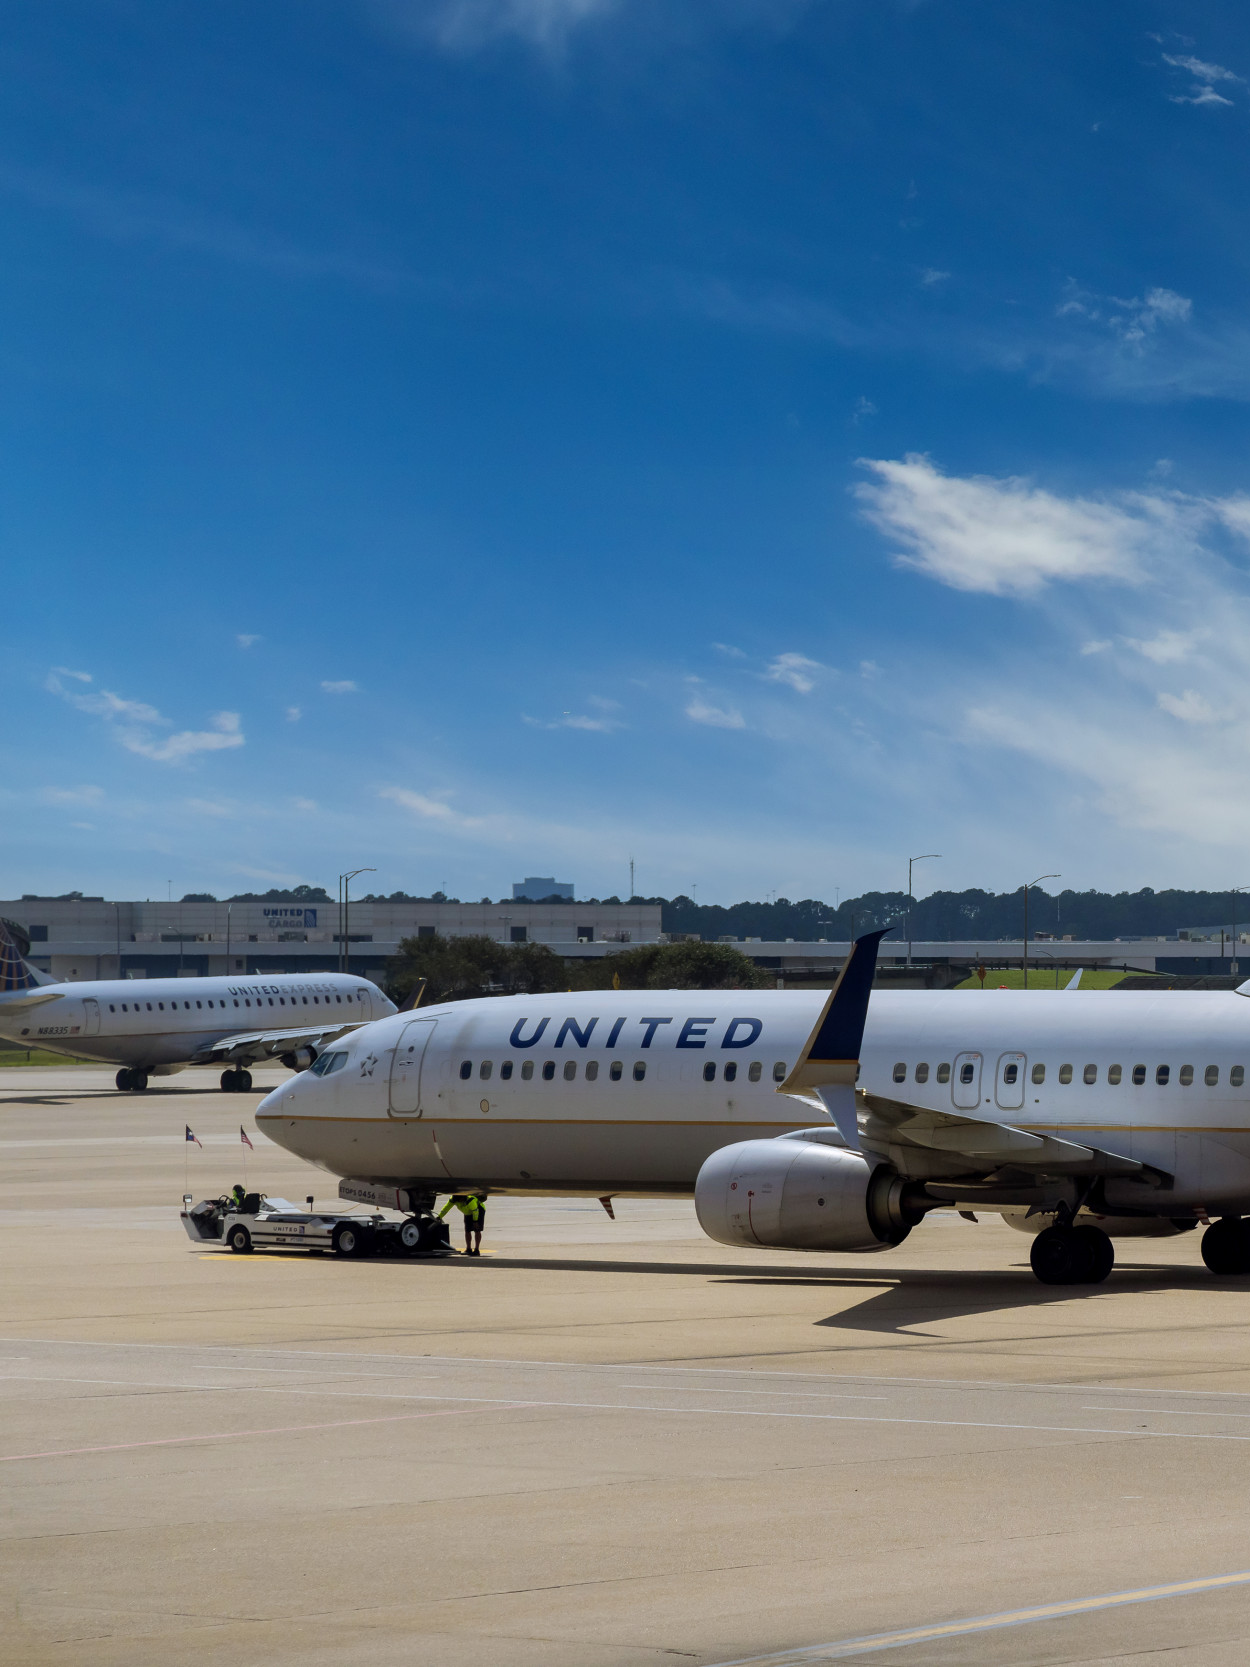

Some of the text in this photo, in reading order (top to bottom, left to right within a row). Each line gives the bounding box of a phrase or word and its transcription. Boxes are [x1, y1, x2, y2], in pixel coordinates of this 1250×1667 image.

[263, 908, 303, 917] UNITED
[268, 919, 303, 928] CARGO
[227, 983, 338, 996] UNITED EXPRESS
[37, 1026, 69, 1035] N88335
[509, 1017, 764, 1049] UNITED
[339, 1186, 357, 1196] ETOPS
[357, 1189, 376, 1200] 0456
